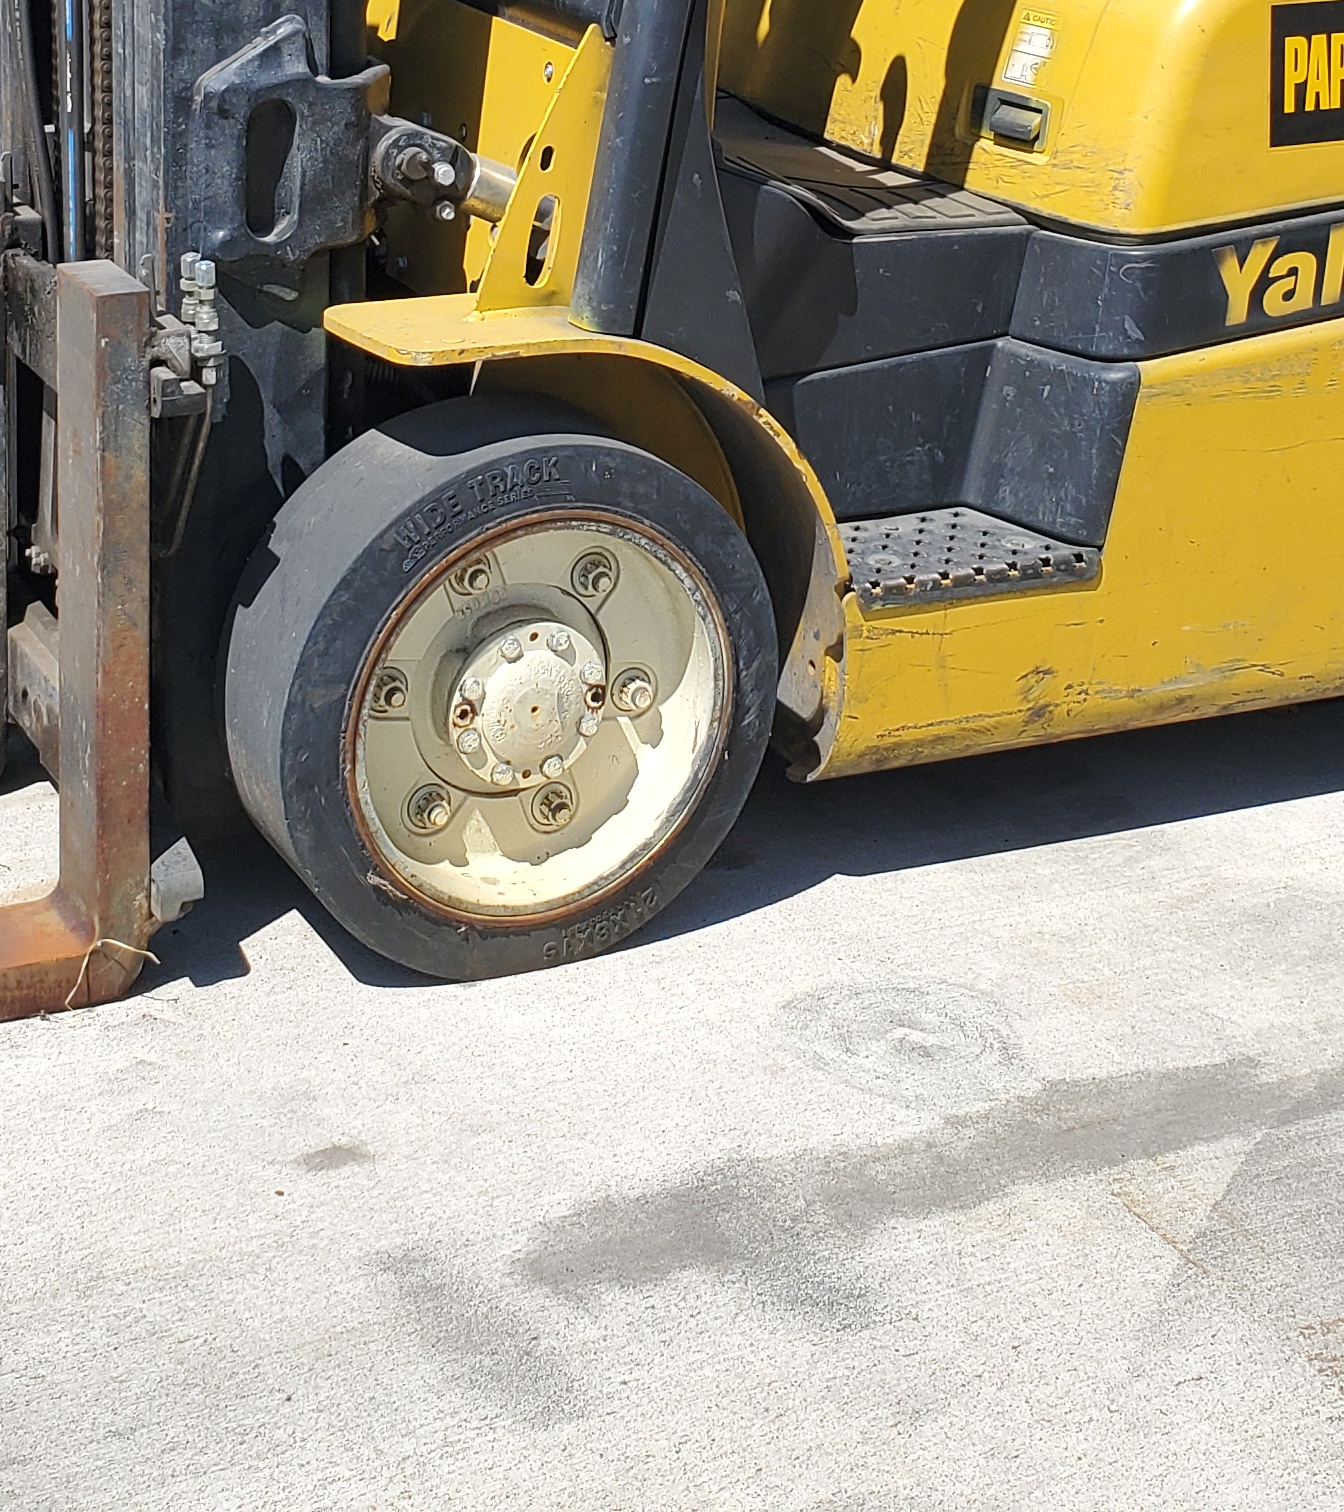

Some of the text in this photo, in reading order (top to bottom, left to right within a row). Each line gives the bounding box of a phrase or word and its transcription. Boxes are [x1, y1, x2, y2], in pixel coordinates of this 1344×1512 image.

[393, 456, 560, 549] WIDE TRACK
[423, 488, 534, 550] PERFORMANCE SERIES
